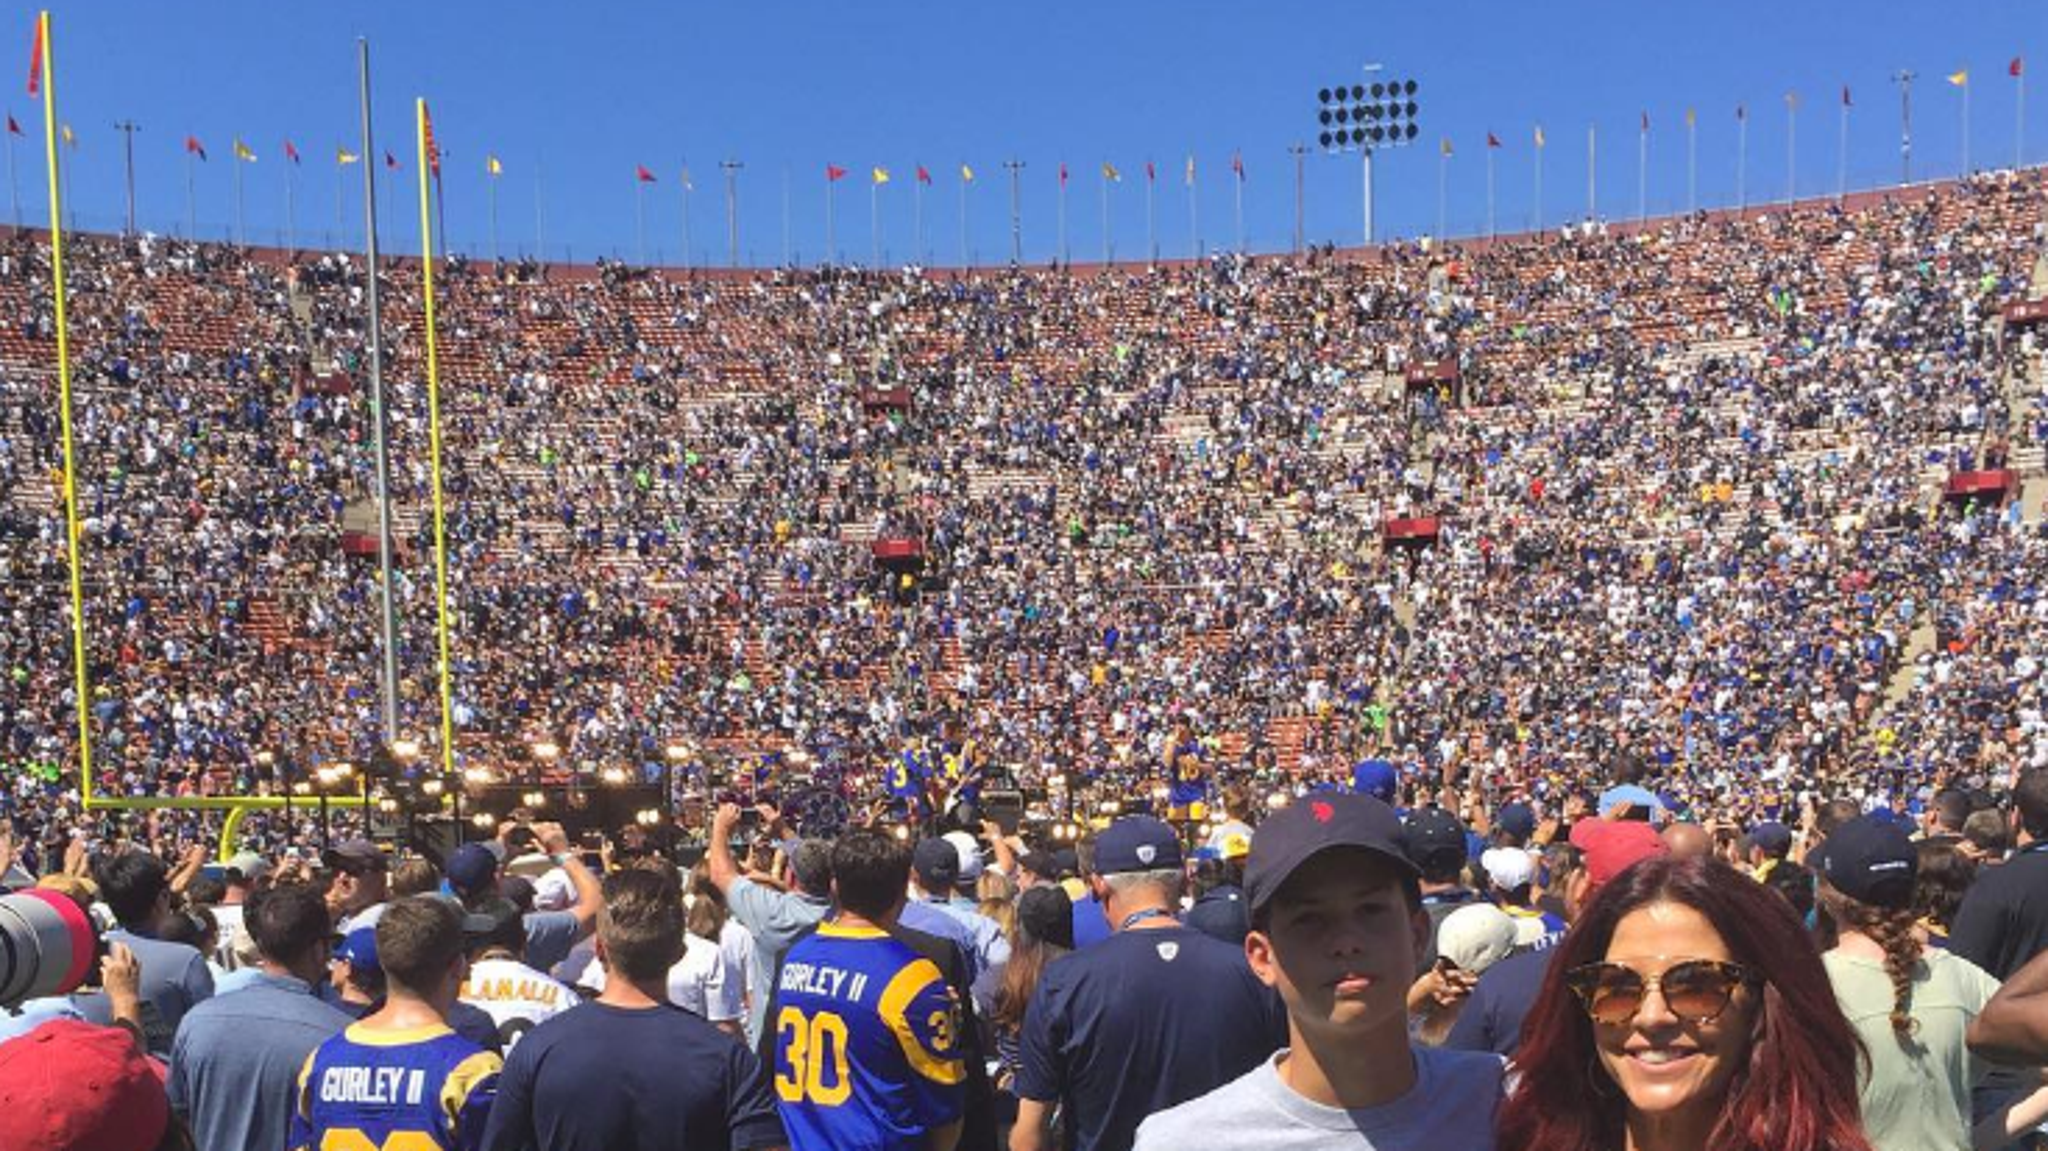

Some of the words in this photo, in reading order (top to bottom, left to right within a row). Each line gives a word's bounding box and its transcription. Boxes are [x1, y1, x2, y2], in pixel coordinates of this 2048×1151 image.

[781, 963, 848, 999] GURLEY
[846, 971, 868, 1002] II
[774, 1005, 852, 1108] 30
[320, 1066, 405, 1105] GURLEY
[405, 1069, 426, 1105] II
